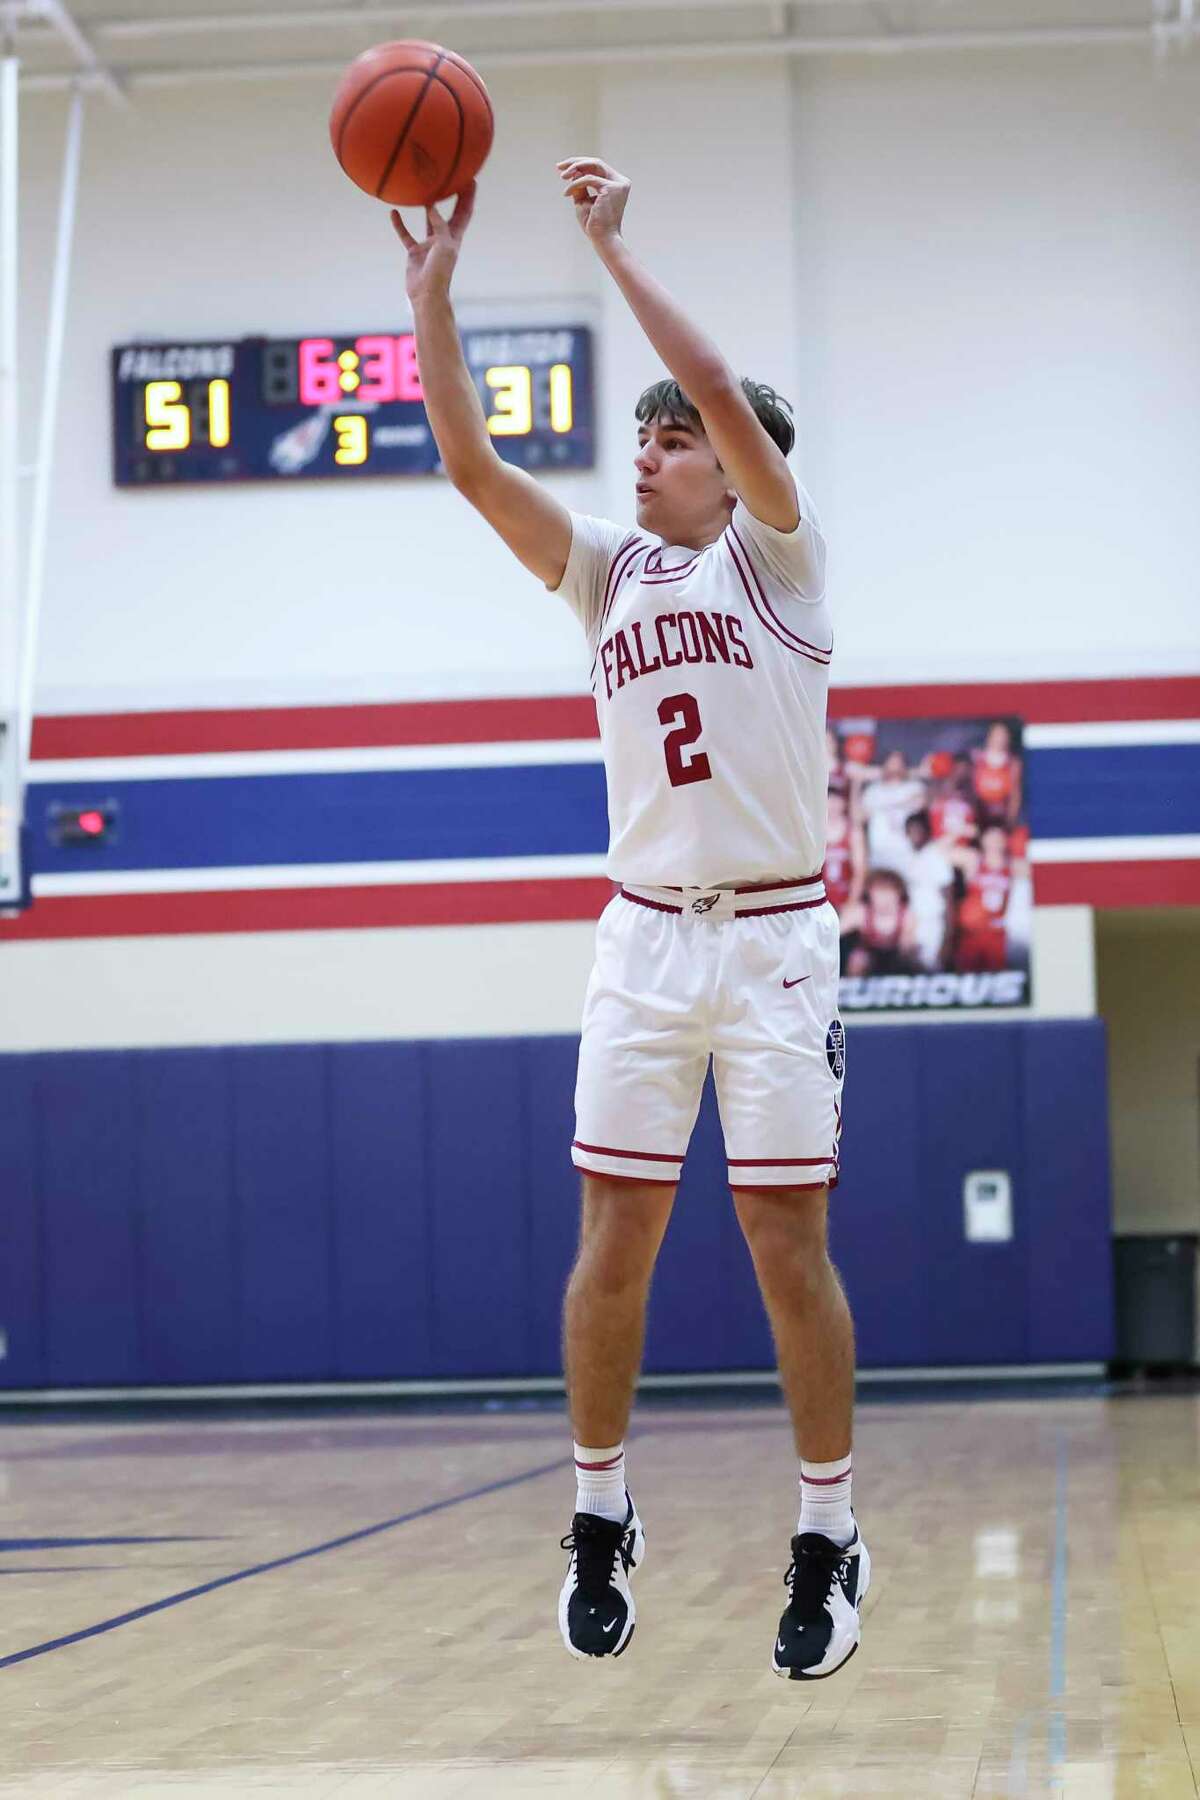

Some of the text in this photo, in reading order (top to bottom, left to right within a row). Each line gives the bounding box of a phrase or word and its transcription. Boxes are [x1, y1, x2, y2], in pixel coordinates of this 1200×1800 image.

[145, 379, 230, 450] 51
[485, 364, 572, 435] 31
[334, 415, 367, 465] 3
[601, 611, 753, 701] FALCONS
[657, 693, 712, 787] 2
[839, 971, 1025, 1007] URIOUS
